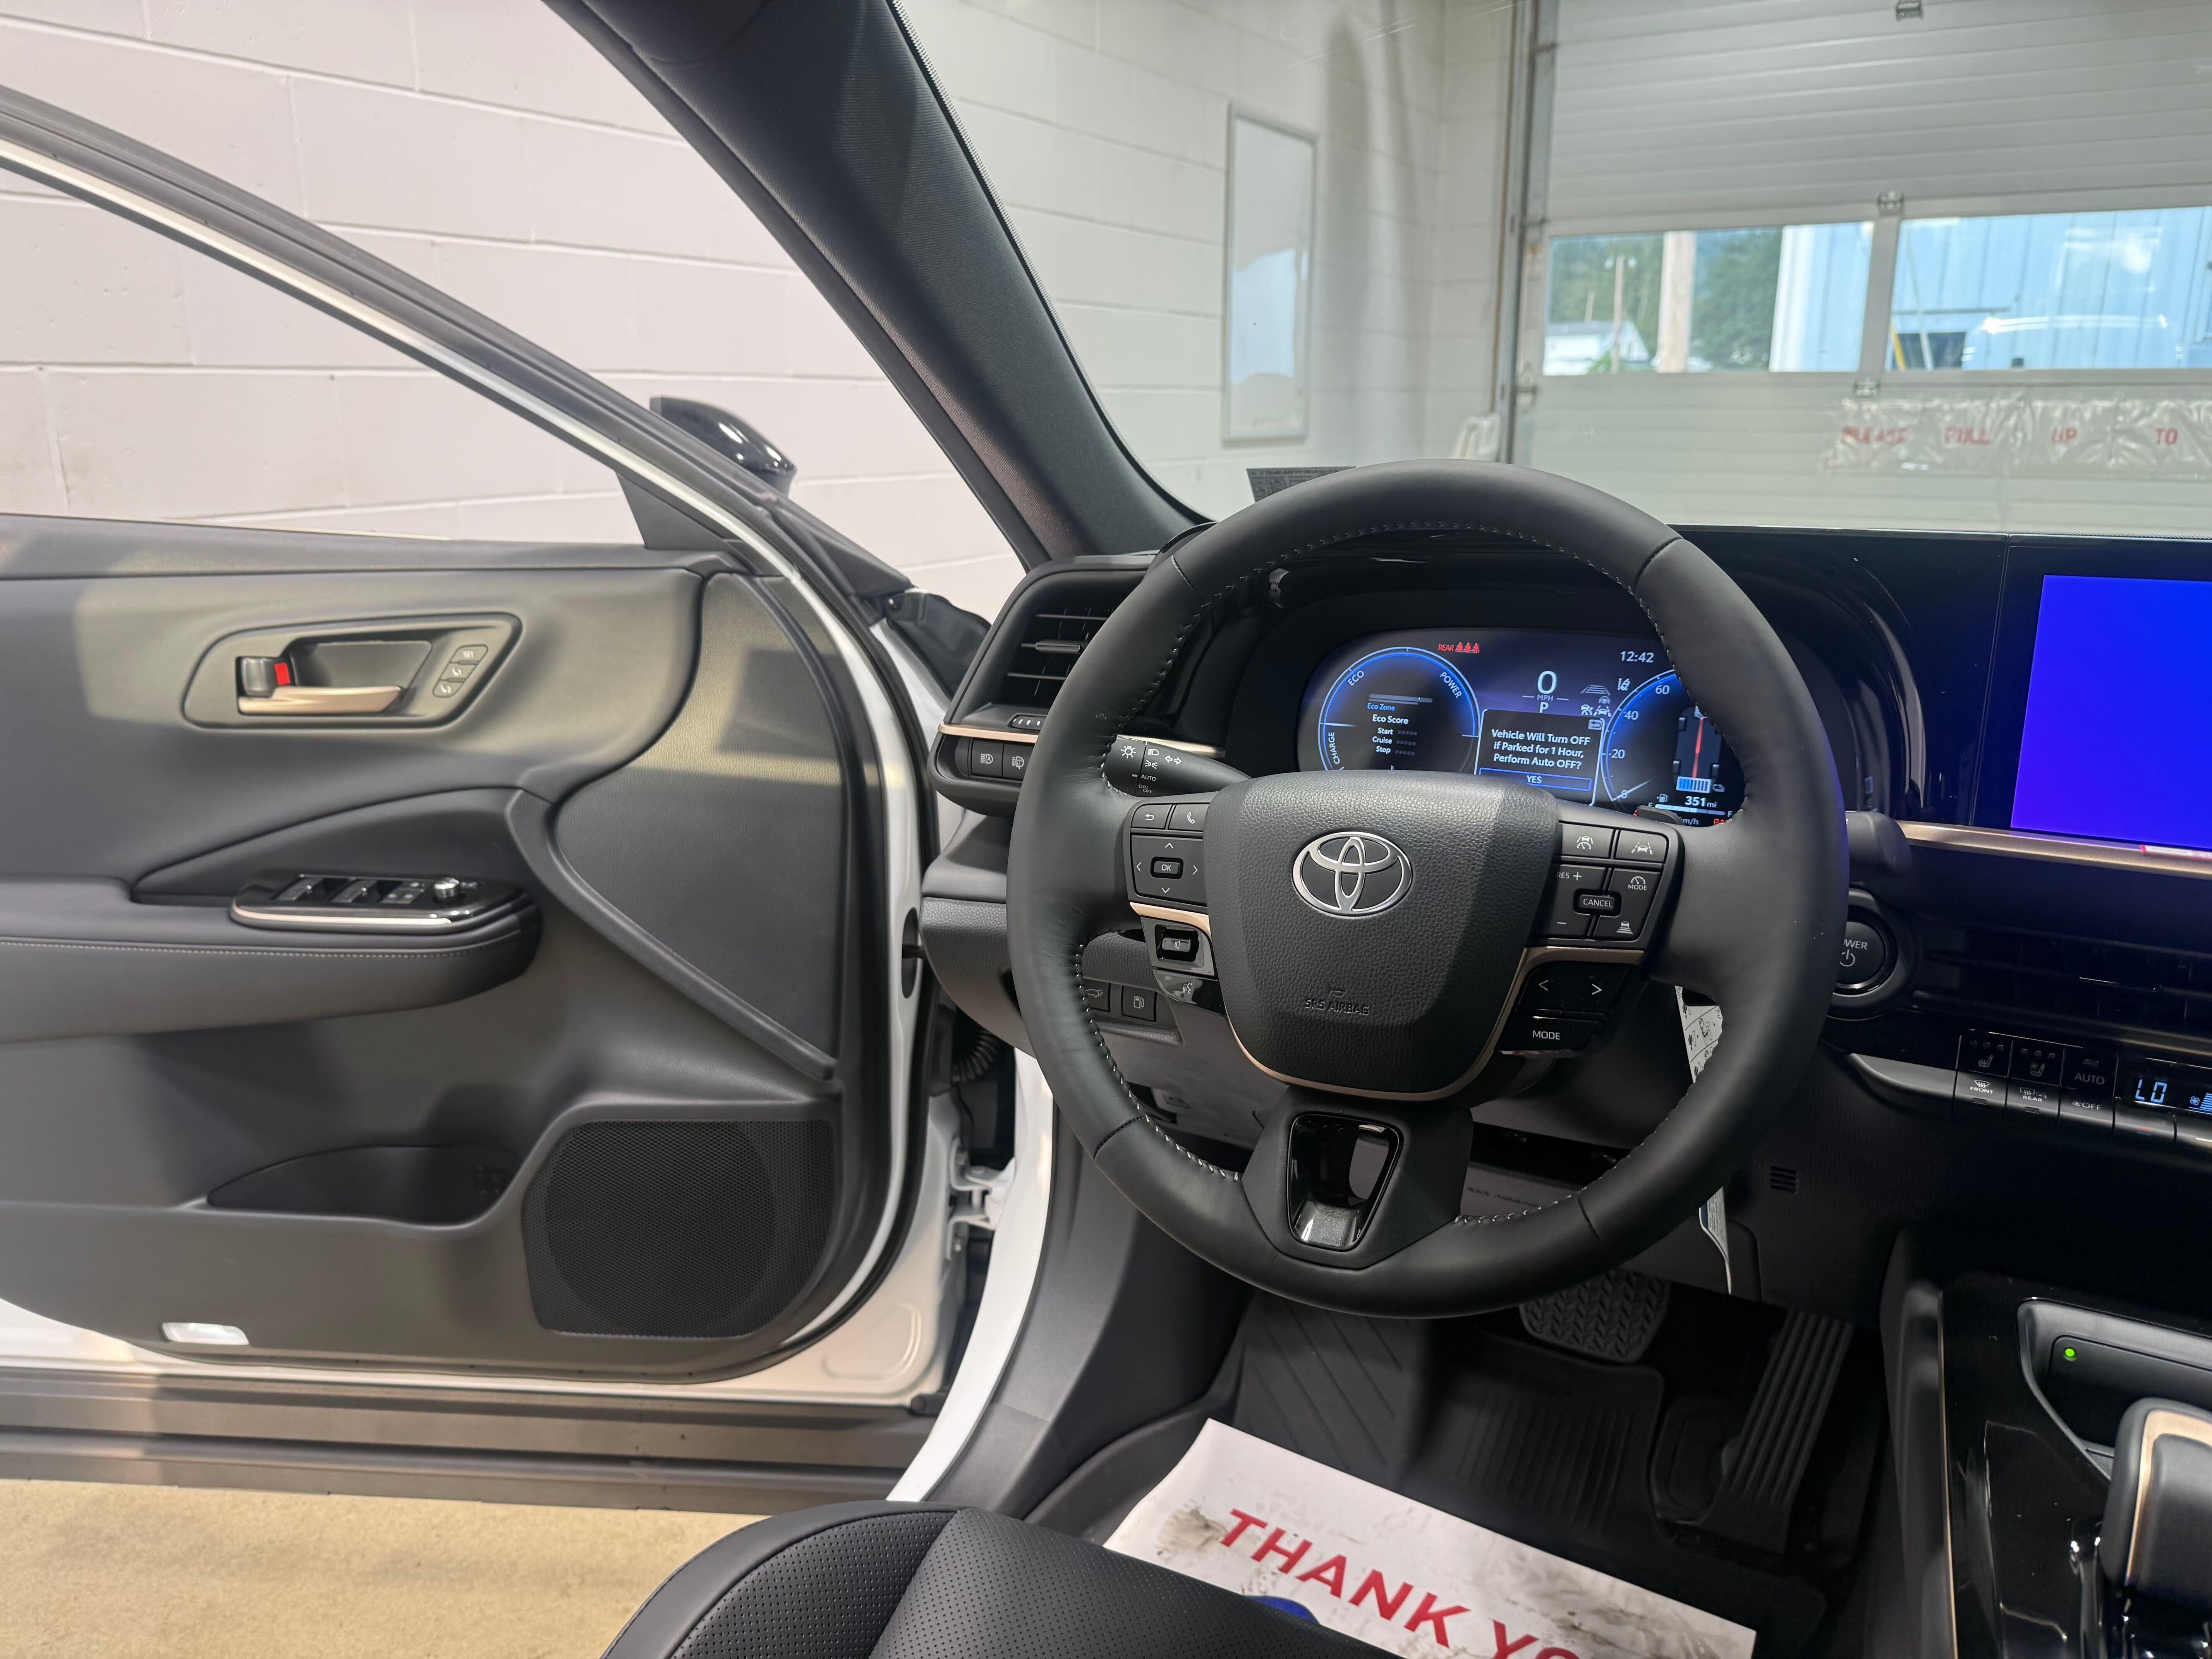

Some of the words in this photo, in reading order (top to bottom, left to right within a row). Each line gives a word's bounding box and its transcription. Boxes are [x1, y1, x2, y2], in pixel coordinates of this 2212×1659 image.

[2051, 426, 2077, 445] UP
[2155, 427, 2179, 445] TO
[1620, 651, 1654, 663] 12:42
[1347, 670, 1365, 686] ECO
[1537, 670, 1557, 694] 0
[1439, 672, 1462, 699] POWER
[1655, 685, 1670, 695] 60
[1367, 702, 1379, 710] Eco
[1379, 703, 1396, 711] Zone
[1539, 702, 1549, 713] P
[1372, 714, 1386, 723] Eco
[1388, 716, 1409, 725] Score
[1624, 710, 1639, 720] 40
[1377, 727, 1394, 735] Start
[1372, 736, 1393, 745] Cruise
[1491, 729, 1525, 740] Vehicle
[1527, 732, 1545, 742] Will
[1547, 733, 1568, 744] Turn
[1570, 736, 1590, 745] OFF
[1328, 732, 1341, 765] CHARGE
[1376, 746, 1391, 754] Stop
[1494, 741, 1501, 750] if
[1502, 742, 1534, 753] Parked
[1535, 745, 1550, 754] for
[1551, 747, 1556, 755] 1
[1558, 747, 1584, 759] Hour,
[1611, 749, 1625, 759] 20
[1493, 753, 1530, 765] Perform
[1531, 757, 1555, 767] Auto
[1556, 759, 1582, 769] OFF?
[1527, 775, 1542, 784] YES
[1685, 796, 1707, 807] 351
[1680, 817, 1699, 825] m/h
[1583, 898, 1613, 907] CANCEL
[1843, 939, 1868, 950] WER
[1304, 998, 1325, 1010] SRS
[1327, 1001, 1370, 1015] AIRBAG
[1532, 1030, 1561, 1040] MODE
[2074, 1072, 2105, 1085] AUTO
[1970, 1086, 1993, 1094] FRONT
[2081, 1102, 2102, 1110] OFF
[1220, 1508, 1471, 1648] THANK
[1491, 1618, 1581, 1659] Y
